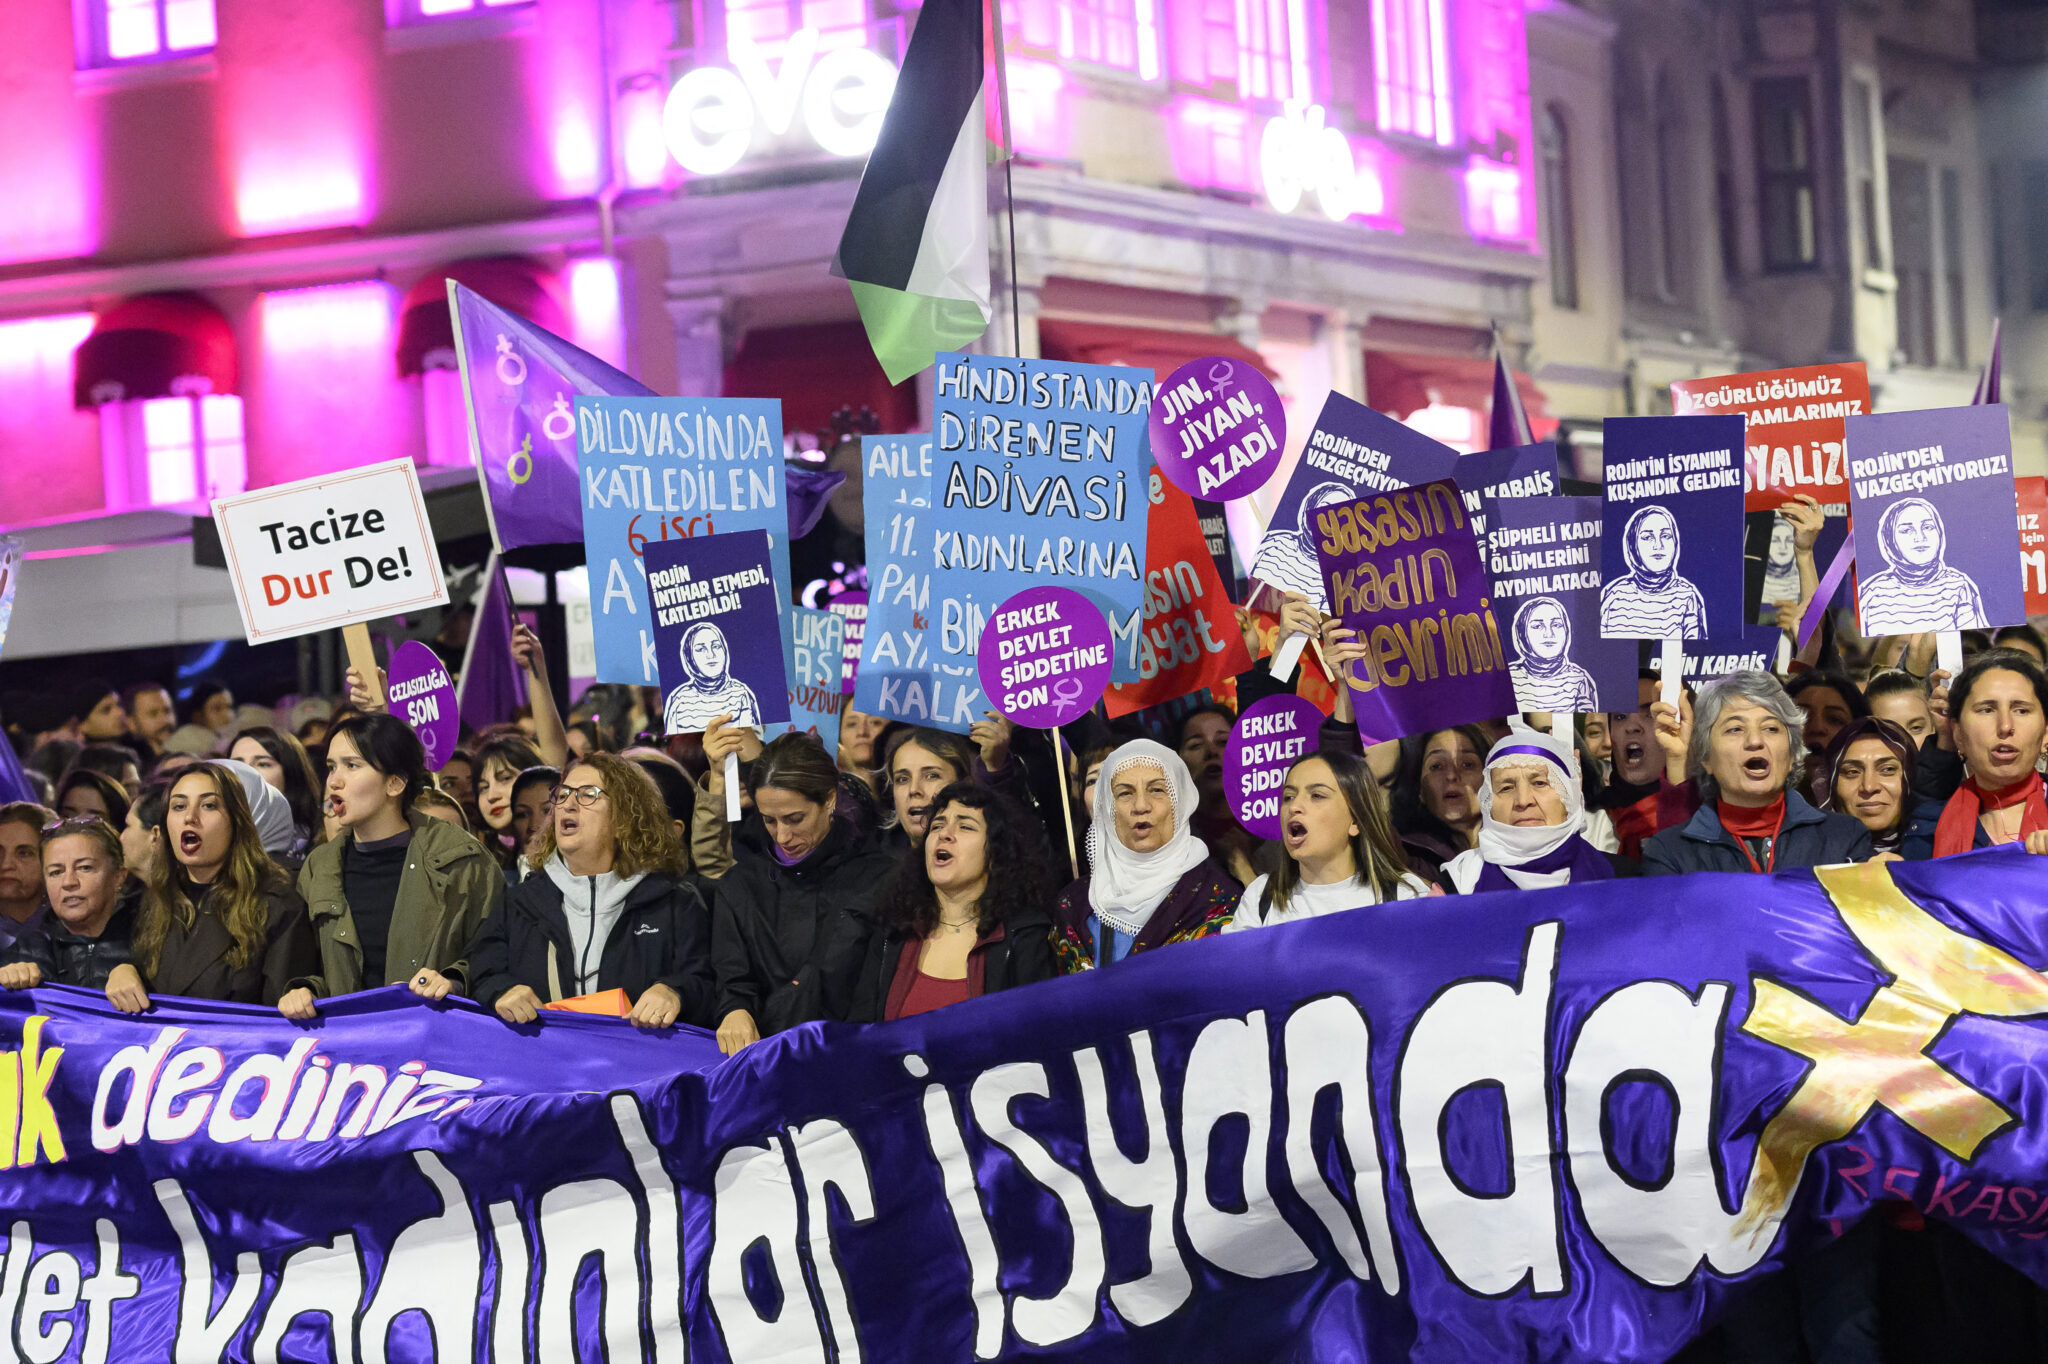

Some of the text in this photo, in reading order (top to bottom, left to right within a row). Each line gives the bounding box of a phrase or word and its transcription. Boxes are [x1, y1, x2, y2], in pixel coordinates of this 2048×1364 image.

[937, 356, 1153, 415] HİNDİSTANDA
[1161, 376, 1213, 425] JIN,
[940, 410, 1116, 463] DİRENEN
[1311, 429, 1392, 472] ROJİN'DEN
[1197, 418, 1278, 497] AZADÎ
[1306, 447, 1410, 492] VAZGEÇMİYO
[1605, 449, 1731, 482] ROJİN'İN İSYANINI
[1851, 445, 1945, 479] ROJİN'DEN
[585, 463, 776, 512] KATLEDİLEN
[944, 461, 1127, 522] ADİVASİ
[1607, 466, 1741, 504] KUŞANDIK GELDİK!
[1854, 454, 2009, 500] VAZGEÇMİYORUZ!
[259, 508, 385, 554] Tacize
[1488, 522, 1557, 552] ŞÜPHELİ
[1560, 520, 1603, 542] KADI
[932, 529, 1141, 581] KADINLARINA
[1490, 543, 1590, 574] ÖLÜMLERİNİ
[261, 546, 412, 607] Dur De!
[649, 564, 691, 589] ROJİN
[711, 564, 770, 595] ETMEDİ,
[1493, 570, 1603, 598] AYDINLATACA
[657, 591, 742, 628] KATLEDİLDİ!
[995, 601, 1062, 634] ERKEK
[998, 625, 1073, 661] DEVLET
[389, 667, 449, 703] CEZASIZLIĞA
[1000, 644, 1108, 690] ŞİDDETİNE
[407, 694, 440, 727] SON
[1003, 685, 1048, 713] SON
[1241, 710, 1297, 739] ERKEK
[1241, 736, 1306, 767] DEVLET
[1241, 796, 1279, 821] SON
[903, 921, 1785, 1362] isyanda
